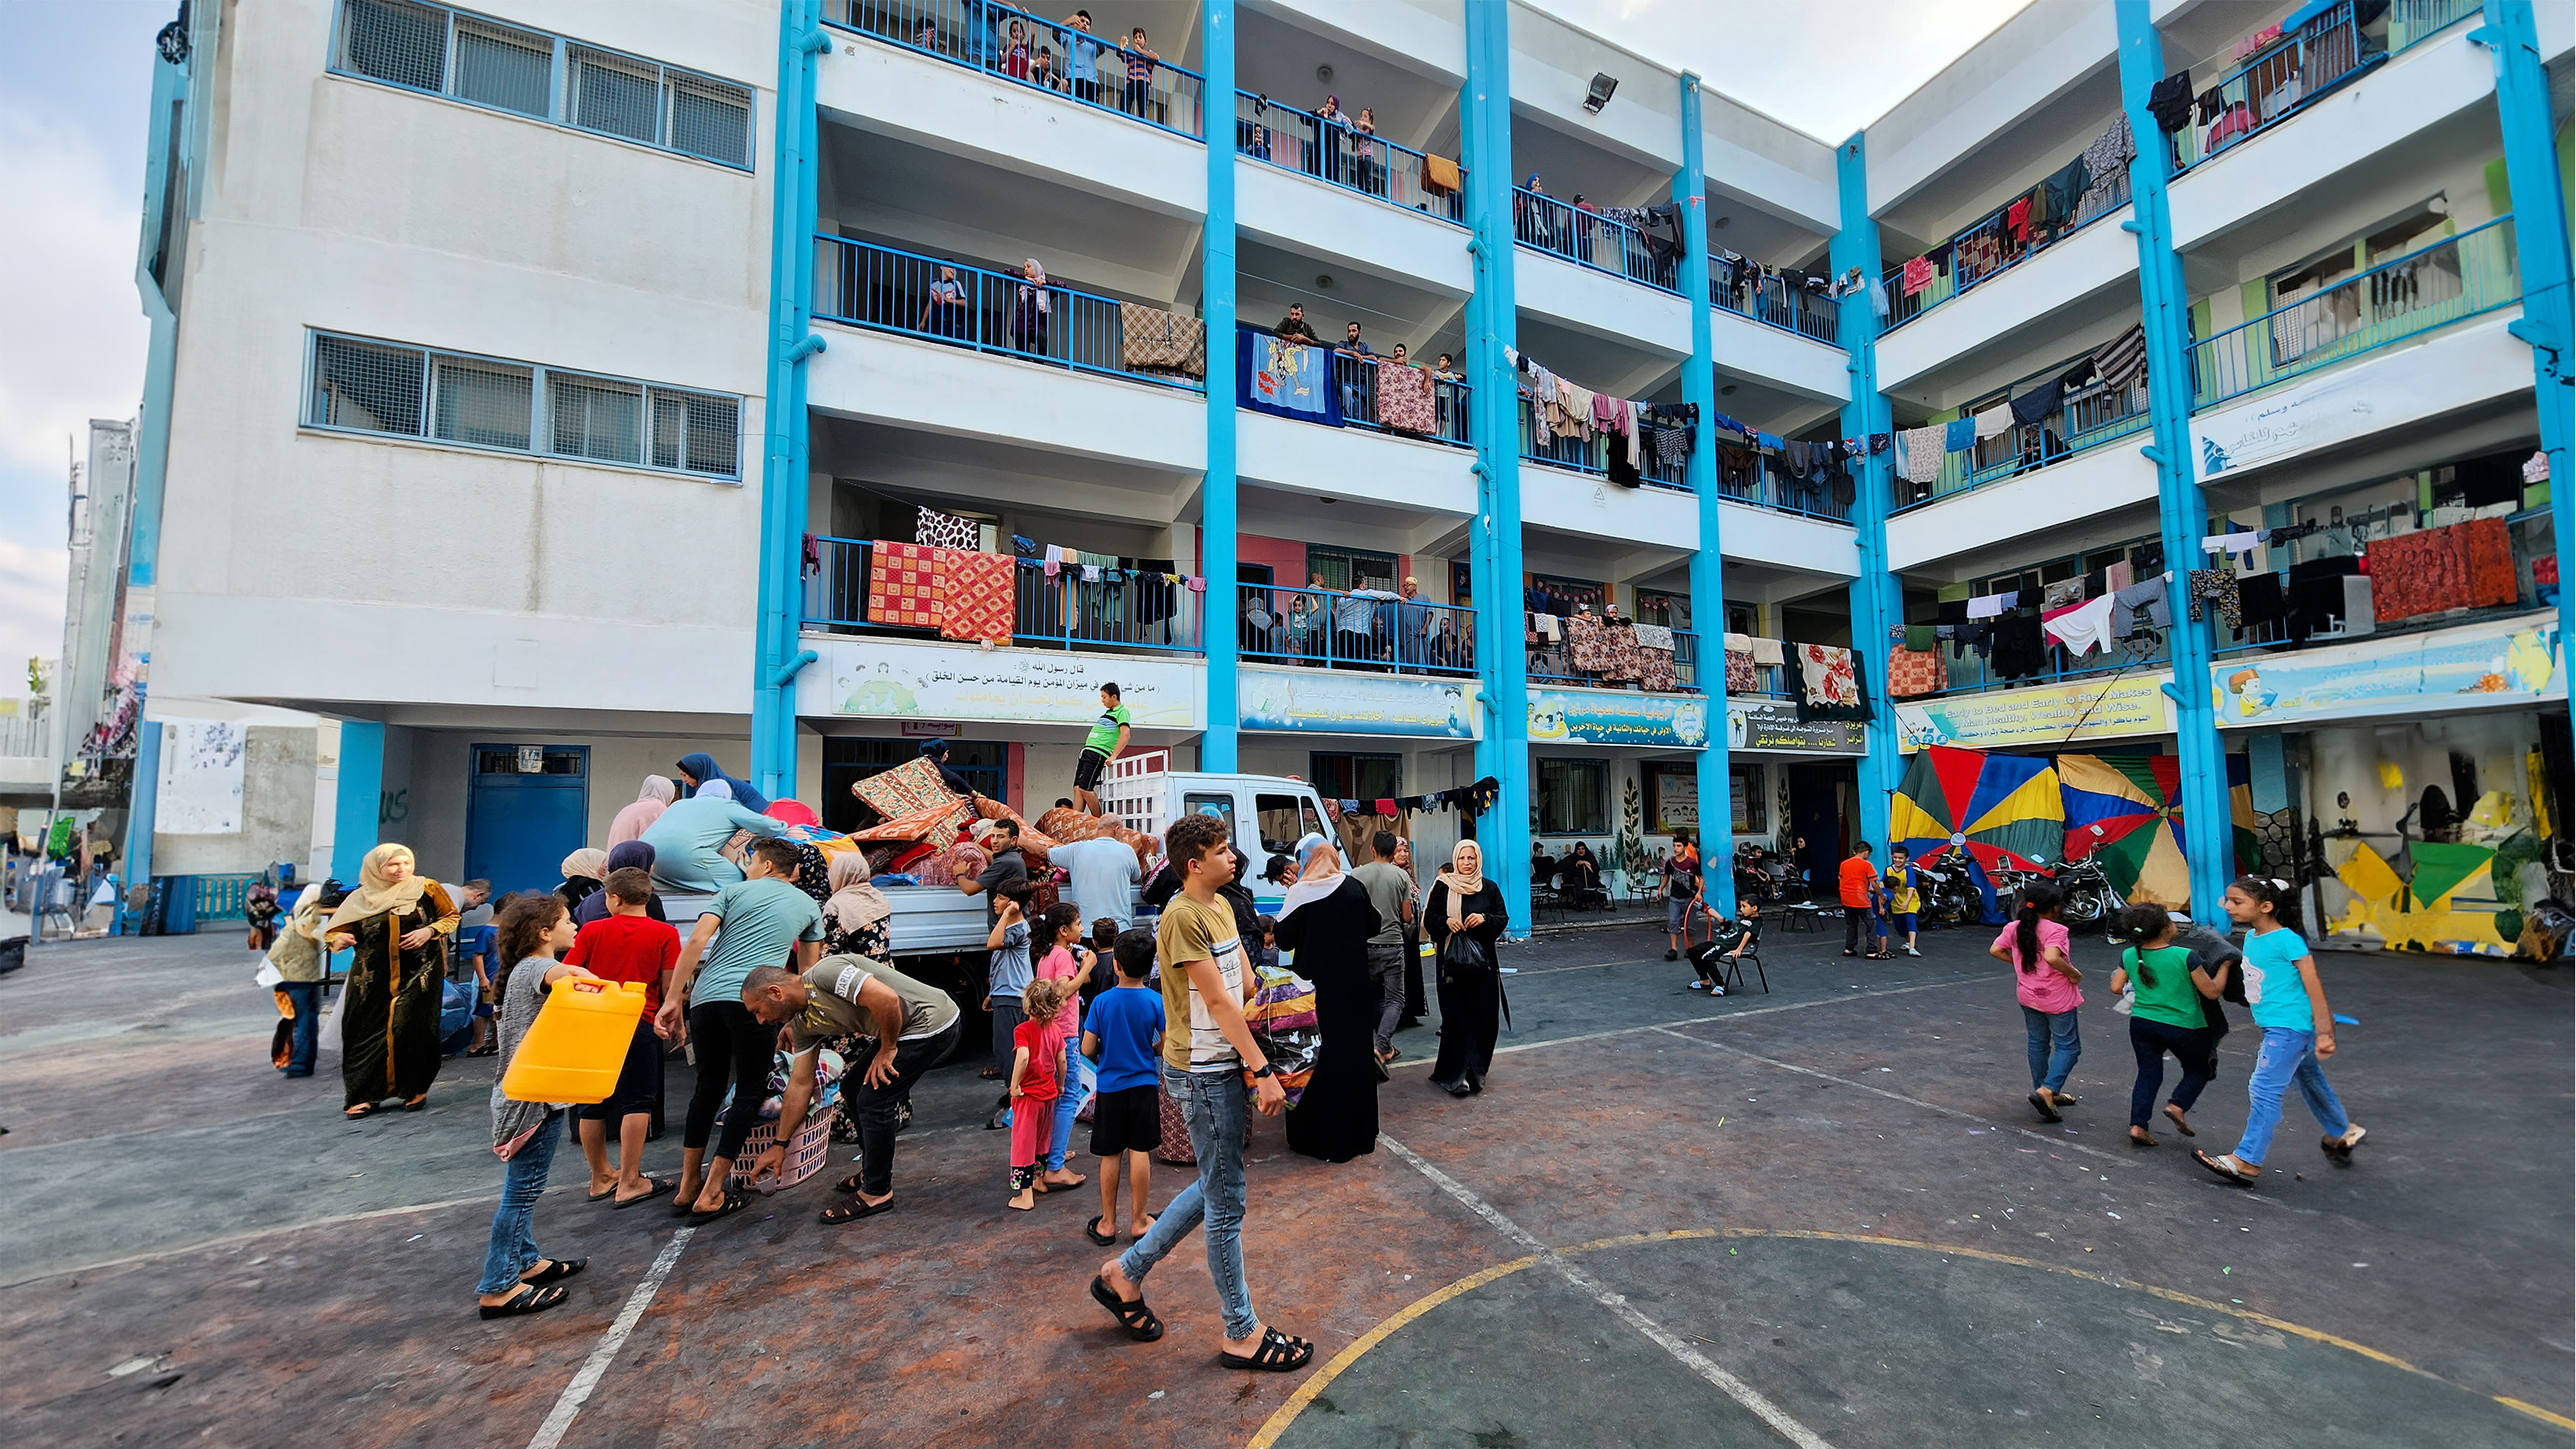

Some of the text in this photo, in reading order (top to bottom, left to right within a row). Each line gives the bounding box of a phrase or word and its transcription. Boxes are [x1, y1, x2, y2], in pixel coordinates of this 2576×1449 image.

[1032, 662, 1045, 671] الله
[1047, 663, 1067, 675] رسول
[1069, 664, 1084, 674] قال
[957, 674, 980, 684] حسن
[982, 676, 994, 685] من
[997, 674, 1026, 686] القيامة
[1028, 679, 1041, 689] يوم
[1042, 678, 1065, 689] المؤمن
[1066, 679, 1088, 690] ميزان
[1133, 683, 1146, 693] من
[1945, 687, 2151, 719] Early to Bed and Early to Rise Makes
[1962, 717, 1983, 728] Man
[1986, 712, 2028, 724] Healthy,
[2030, 709, 2076, 720] Wealthy
[2079, 704, 2102, 714] and
[2106, 701, 2141, 712] Wise.
[1633, 725, 1649, 734] حياتك
[1818, 737, 1836, 748] شعارنا
